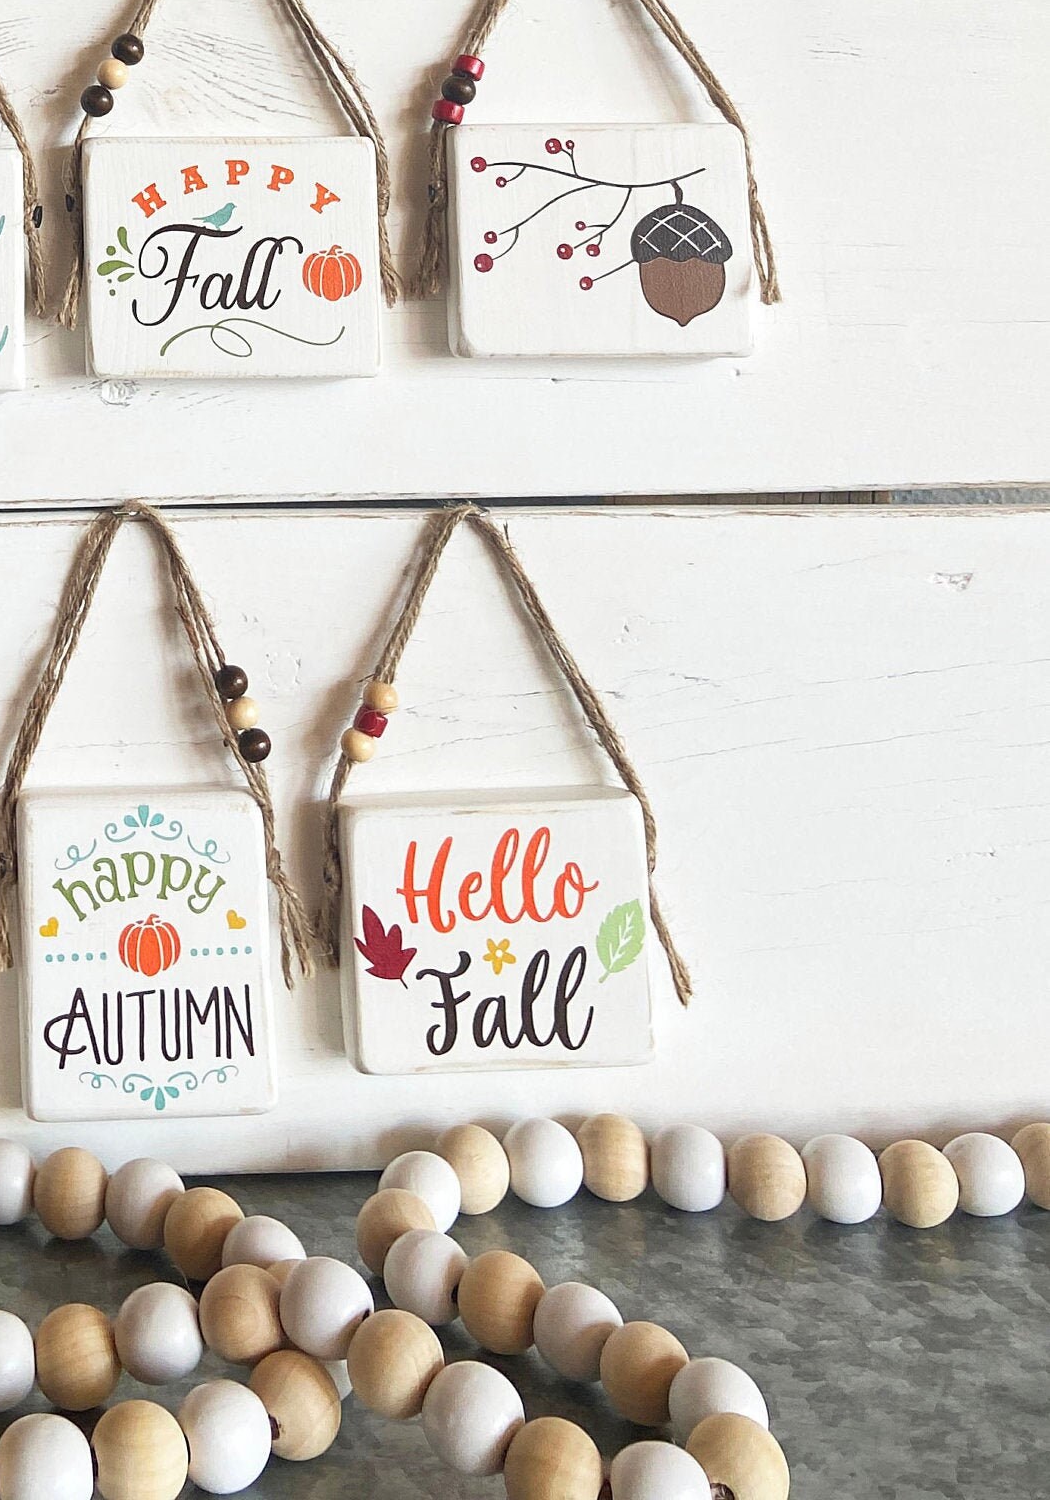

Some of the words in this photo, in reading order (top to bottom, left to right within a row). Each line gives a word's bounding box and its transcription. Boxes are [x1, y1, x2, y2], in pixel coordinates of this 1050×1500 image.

[130, 159, 341, 219] HAPPY
[132, 223, 303, 327] Fall
[53, 850, 227, 921] happy
[396, 827, 599, 933] Hello
[43, 984, 255, 1069] AUTUMN
[416, 946, 594, 1055] Fall
